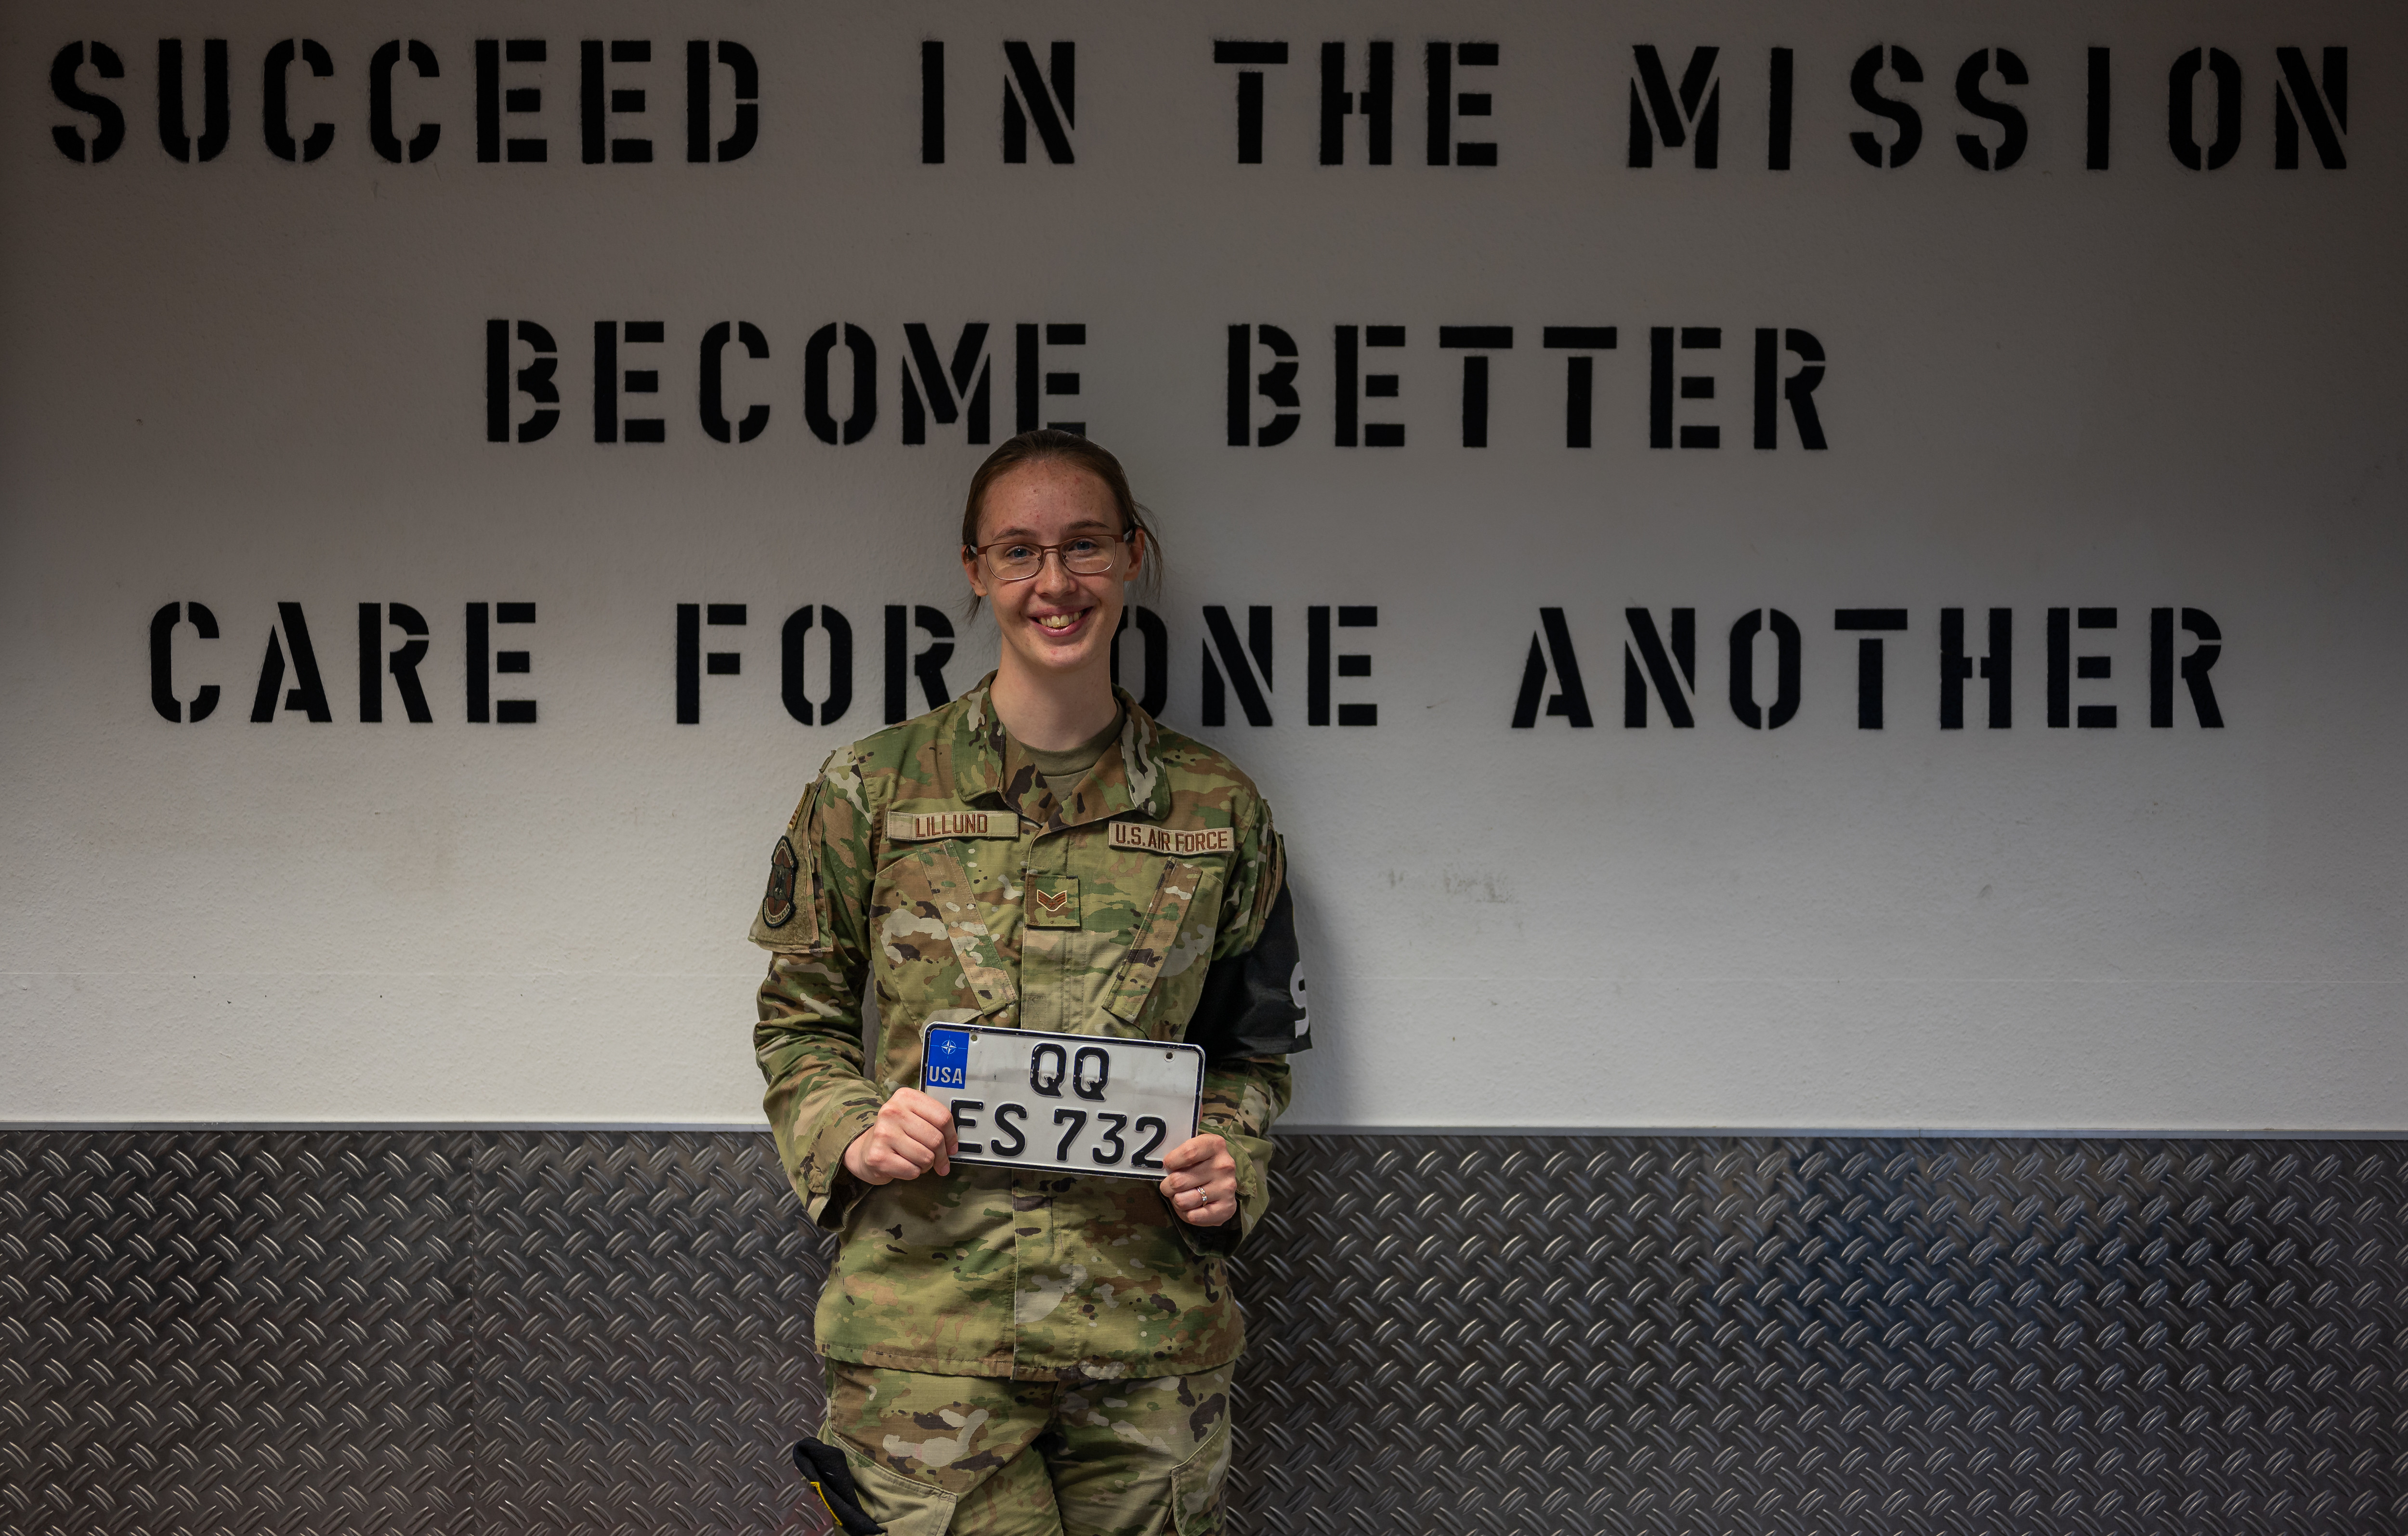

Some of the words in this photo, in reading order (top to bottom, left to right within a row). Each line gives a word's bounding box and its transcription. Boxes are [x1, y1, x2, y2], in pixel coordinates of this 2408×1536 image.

[49, 38, 759, 164] SUCCEED
[922, 40, 1075, 165] IN
[1214, 40, 1499, 166] THE
[1628, 44, 2348, 171] MISSION
[486, 320, 1086, 446] BECOME
[1227, 324, 1828, 450] BETTER
[150, 602, 537, 724] CARE
[676, 604, 955, 726] FOR
[1512, 607, 2225, 730] ANOTHER
[916, 814, 988, 838] LILLUND
[1115, 824, 1146, 846] U.S.
[1148, 828, 1171, 851] AIR
[1175, 830, 1228, 853] FORCE
[929, 1065, 963, 1085] USA
[1030, 1042, 1110, 1102] QQ
[950, 1098, 1028, 1157] ES
[1053, 1107, 1168, 1169] 732
